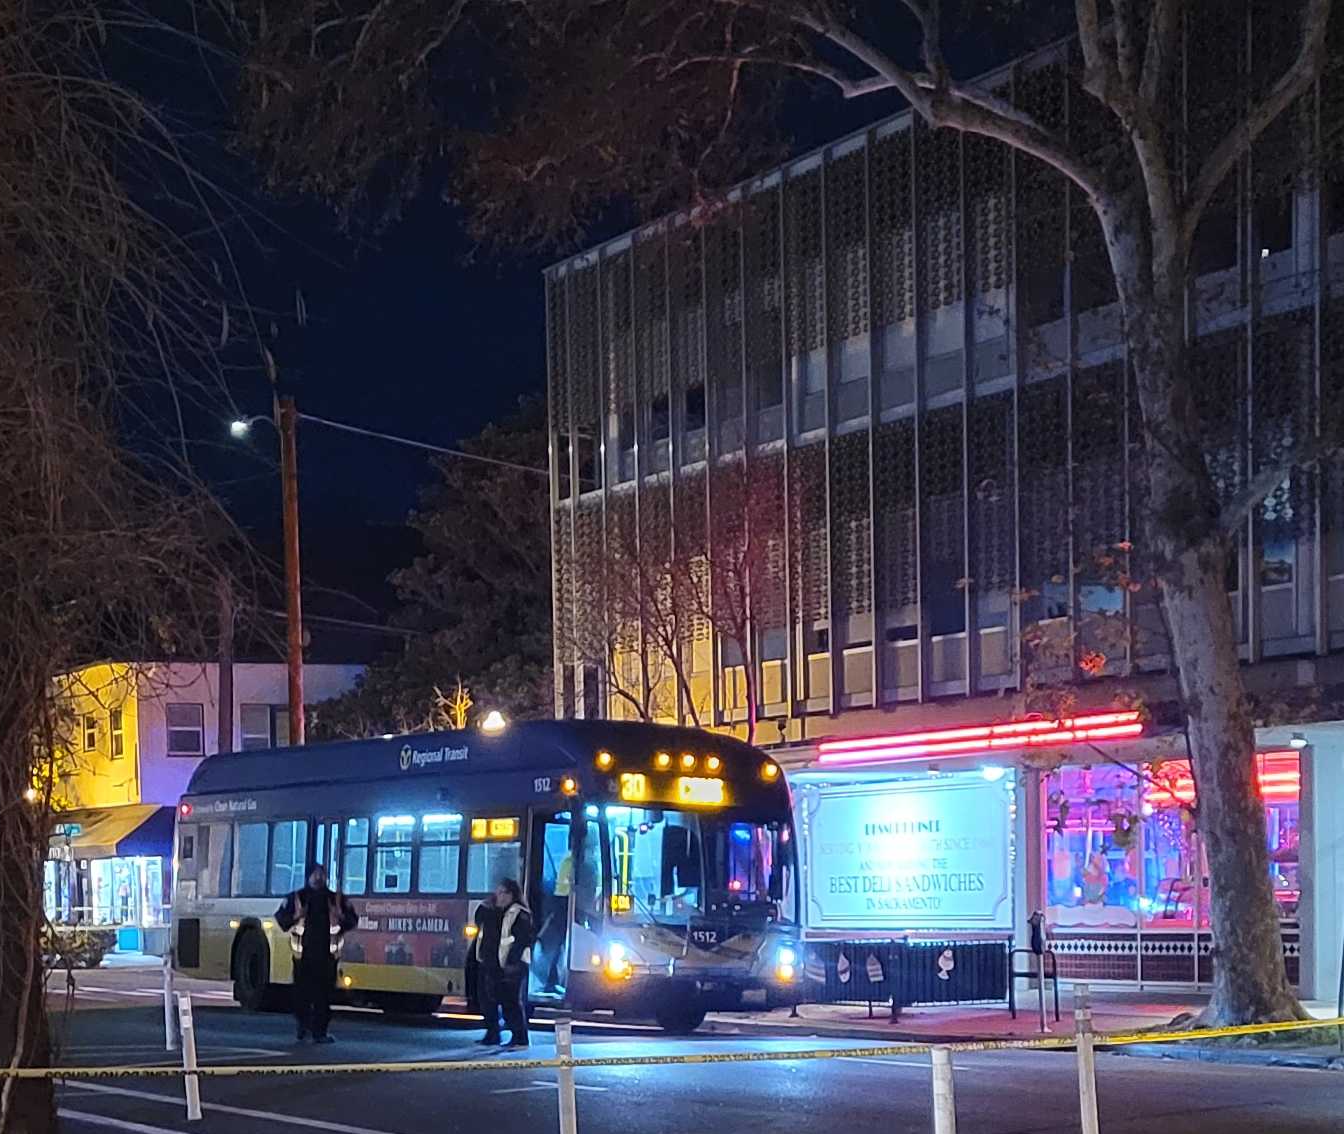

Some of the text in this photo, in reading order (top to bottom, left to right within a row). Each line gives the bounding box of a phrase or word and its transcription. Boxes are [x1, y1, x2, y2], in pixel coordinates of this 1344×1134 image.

[412, 746, 468, 767] Regional Transit
[534, 777, 551, 792] 1512
[620, 772, 647, 801] 30
[829, 876, 859, 893] BEST
[416, 918, 449, 932] CAMERA
[693, 931, 717, 943] 1512
